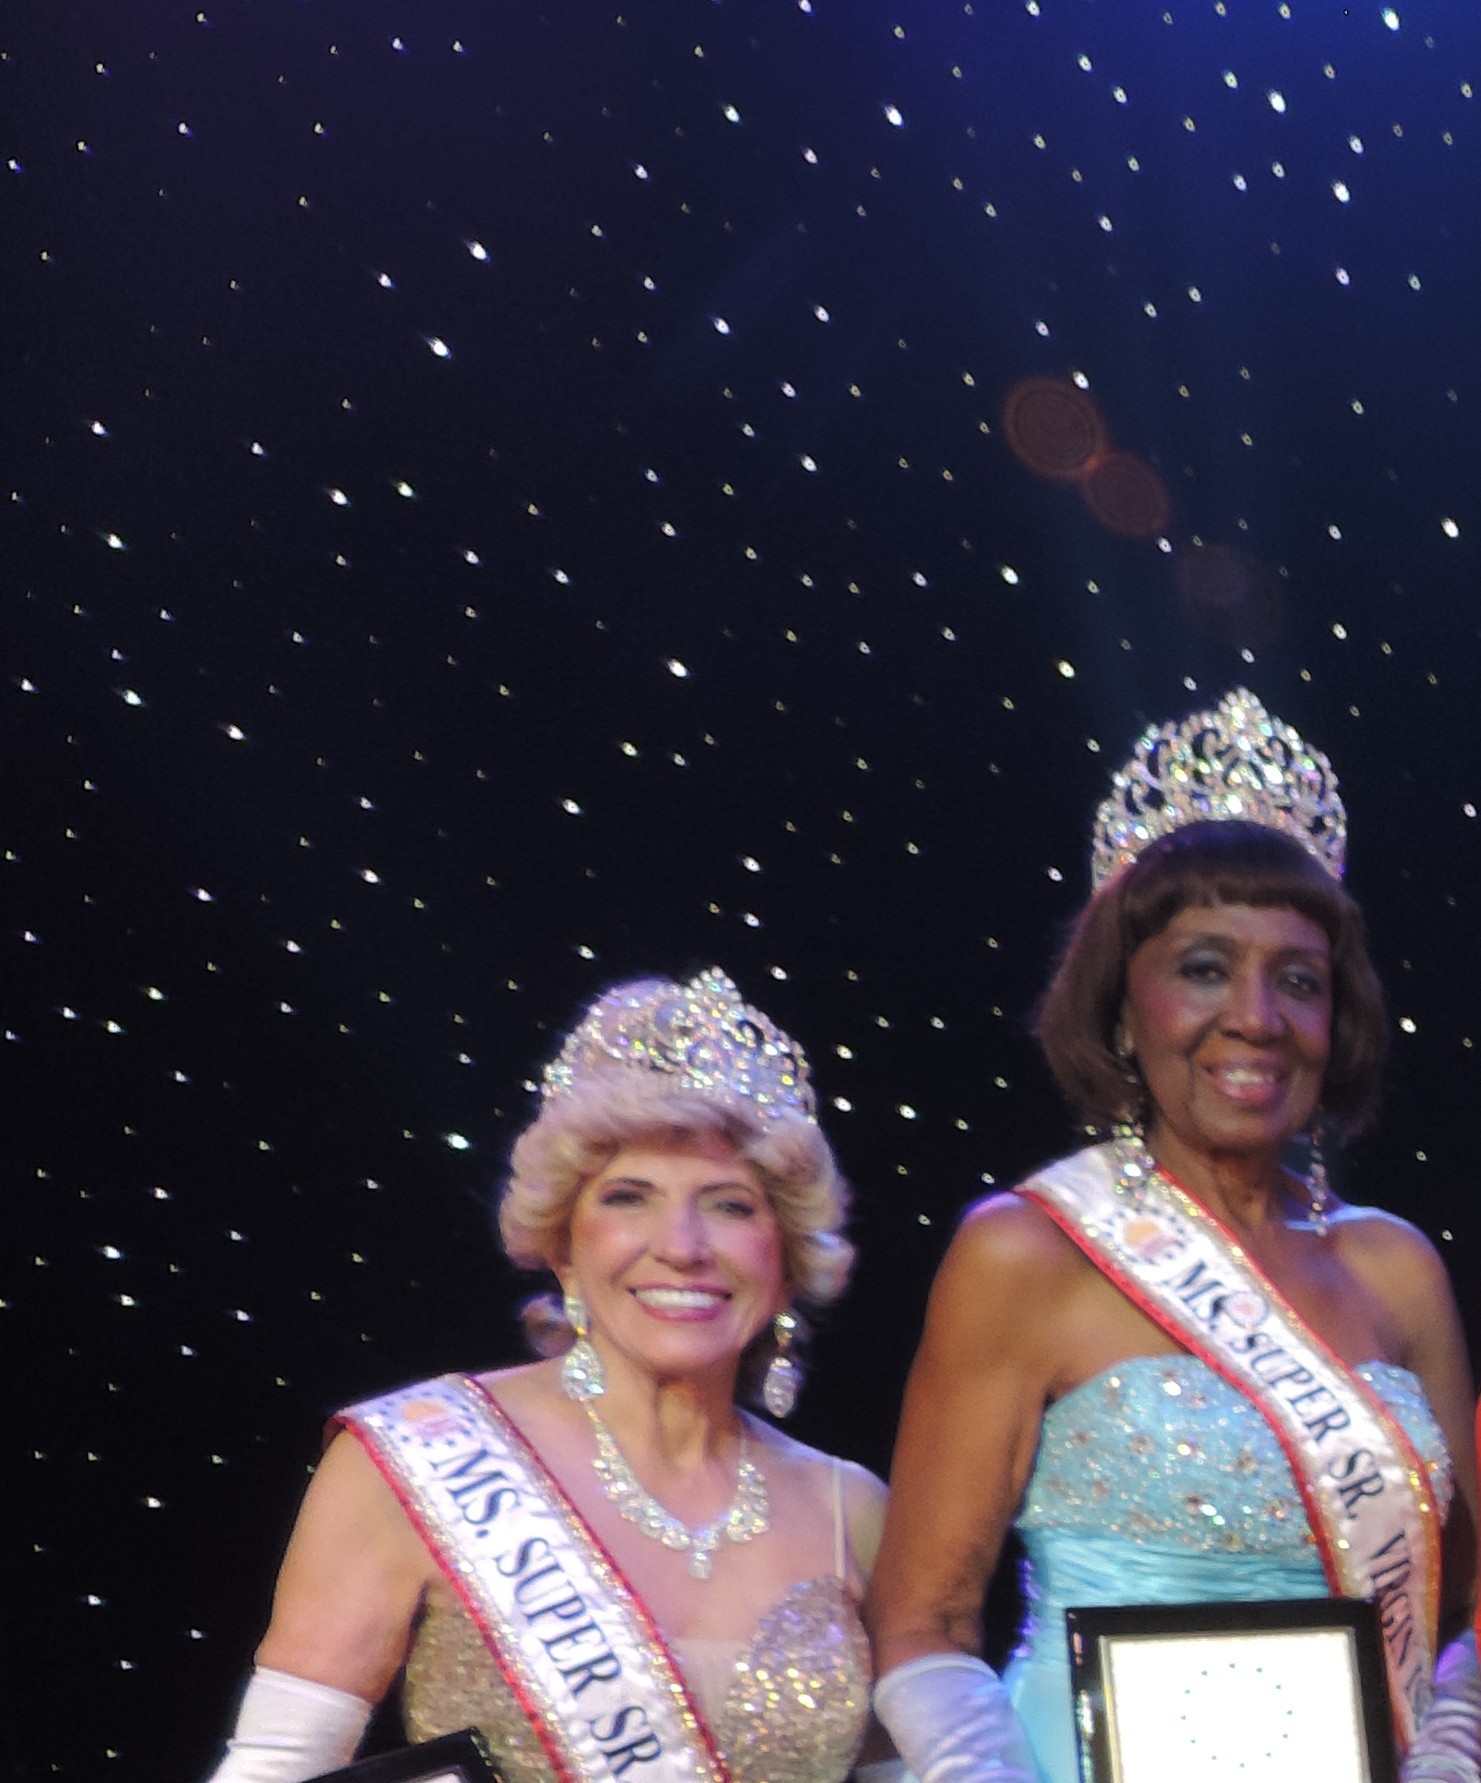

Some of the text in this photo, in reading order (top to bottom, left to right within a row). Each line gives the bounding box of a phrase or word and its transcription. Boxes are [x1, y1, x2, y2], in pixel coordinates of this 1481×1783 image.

[1160, 1260, 1228, 1335] MS.
[1229, 1325, 1351, 1447] SUPER
[1329, 1449, 1385, 1521] SR.
[432, 1446, 521, 1543] MS.
[493, 1538, 623, 1697] SUPER
